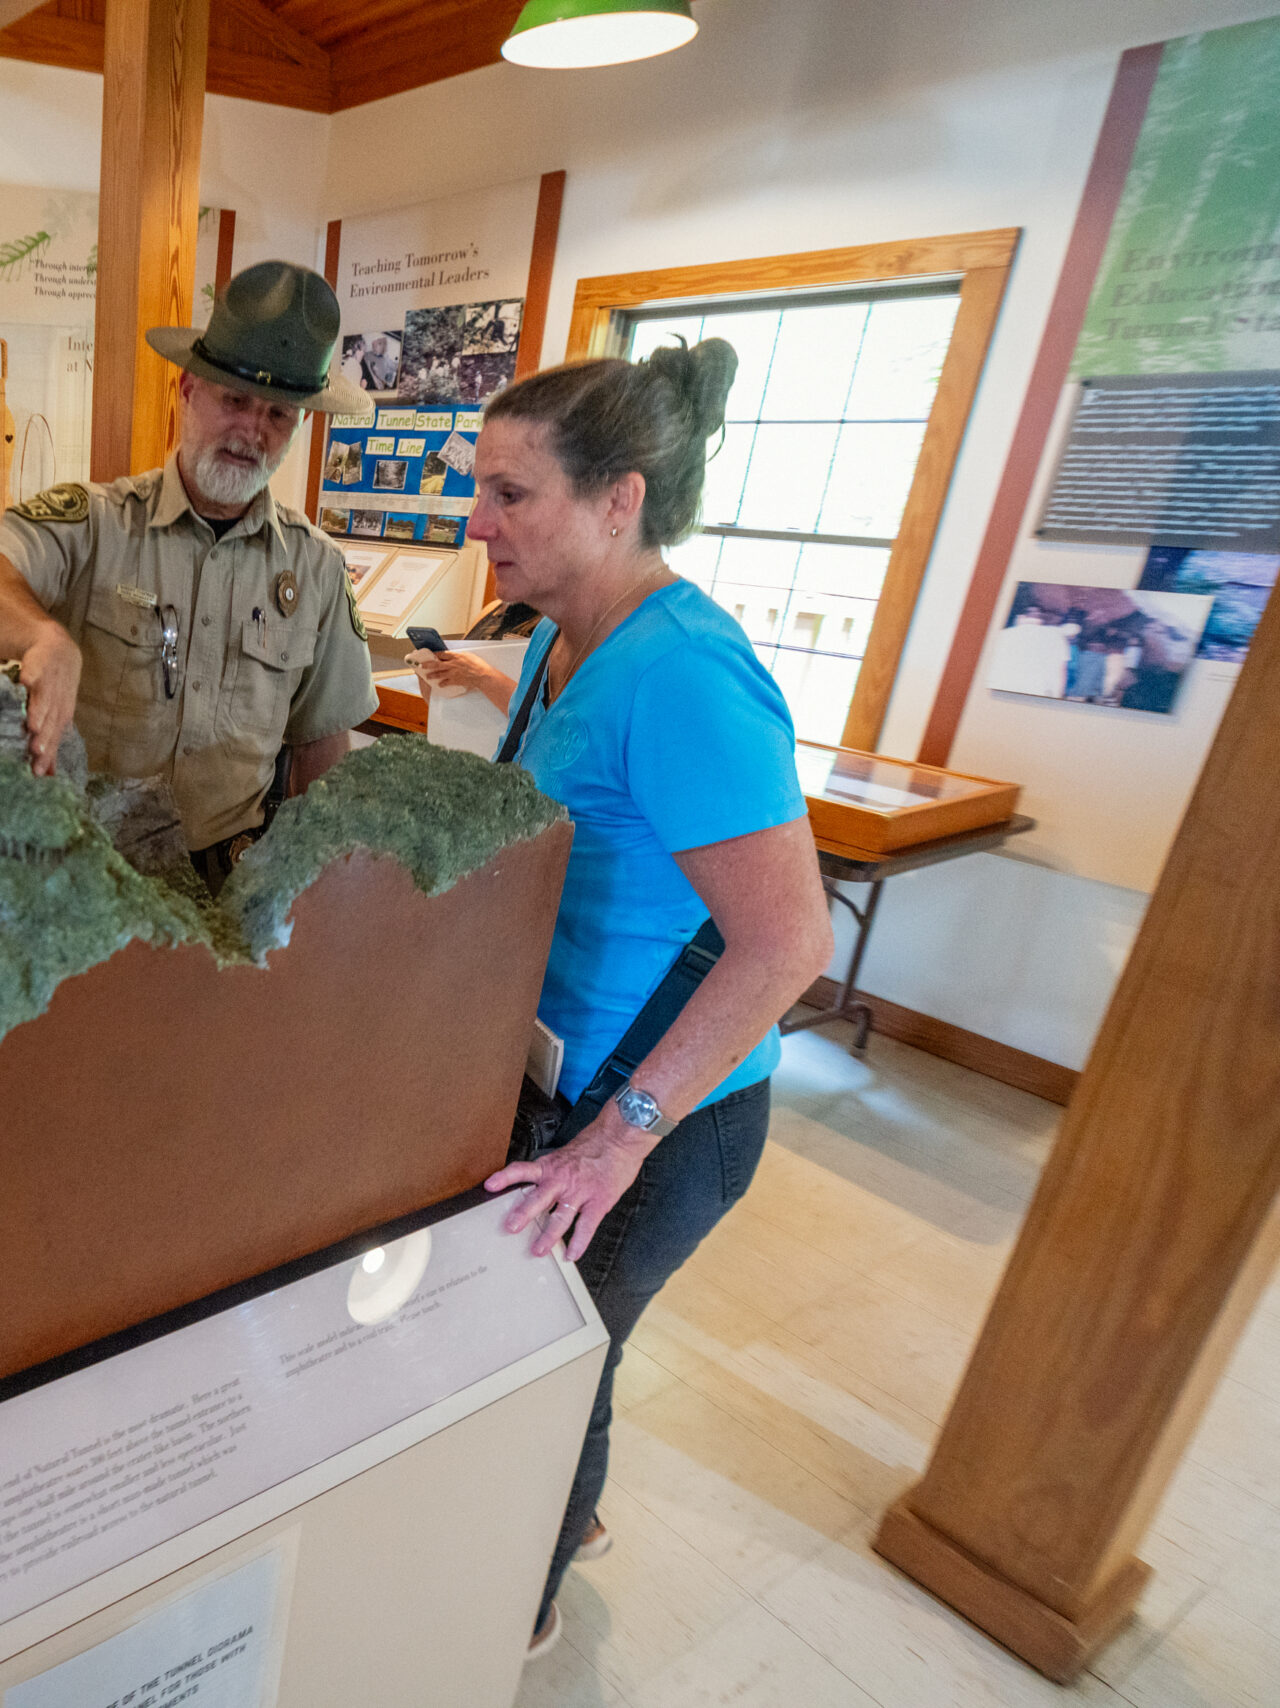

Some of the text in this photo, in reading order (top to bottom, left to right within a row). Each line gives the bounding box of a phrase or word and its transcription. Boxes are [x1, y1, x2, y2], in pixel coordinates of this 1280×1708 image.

[34, 273, 67, 285] Through
[34, 286, 66, 299] Through
[350, 266, 490, 298] Environmental Leaders
[352, 243, 479, 277] Teaching Tomorrow's
[333, 413, 374, 426] Natural
[379, 413, 415, 426] Tunnel
[416, 414, 451, 428] State
[368, 438, 422, 454] Time Line
[279, 1353, 296, 1364] This
[316, 1331, 337, 1348] model
[445, 1274, 470, 1288] relation
[477, 1265, 487, 1273] the
[285, 1351, 331, 1378] amphitheatre
[334, 1341, 347, 1355] and
[2, 1473, 20, 1488] end
[22, 1467, 32, 1479] of
[33, 1451, 69, 1472] Natural
[69, 1437, 101, 1458] Tunnel
[111, 1430, 125, 1440] the
[191, 1391, 211, 1404] Here
[220, 1377, 240, 1393] great
[3, 1475, 62, 1507] amphitheatre
[106, 1446, 122, 1459] feet
[125, 1436, 148, 1451] above
[150, 1429, 163, 1439] the
[165, 1413, 191, 1432] tunnel
[192, 1401, 225, 1419] entrance
[226, 1396, 236, 1404] to
[78, 1467, 109, 1490] around
[111, 1463, 124, 1474] the
[198, 1421, 214, 1433] The
[216, 1405, 251, 1425] northern
[3, 1530, 19, 1542] the
[21, 1512, 51, 1533] tunnel
[63, 1488, 107, 1513] somewhat
[142, 1462, 158, 1477] and
[9, 1567, 20, 1576] to
[128, 1509, 138, 1517] to
[139, 1501, 153, 1512] the
[155, 1481, 186, 1504] natural
[16, 1521, 76, 1555] amphitheatre
[167, 1461, 195, 1481] tunnel
[196, 1450, 220, 1467] which
[221, 1444, 237, 1454] was
[122, 1689, 137, 1706] OF
[140, 1676, 161, 1694] THE
[164, 1653, 203, 1681] TUNNEL
[207, 1625, 254, 1657] DIORAMA
[160, 1643, 247, 1698] FOR THOSE WITH
